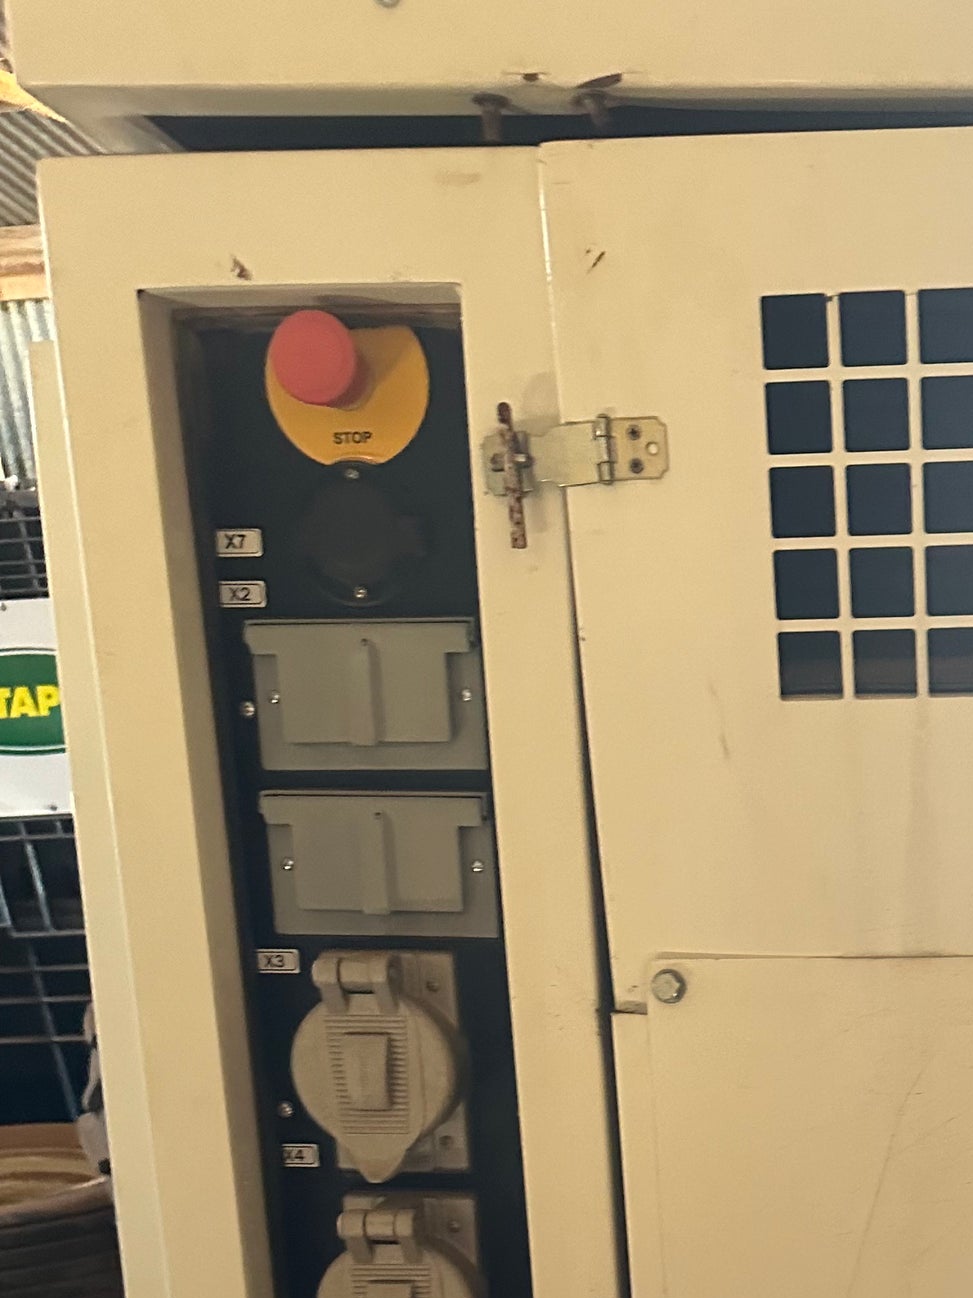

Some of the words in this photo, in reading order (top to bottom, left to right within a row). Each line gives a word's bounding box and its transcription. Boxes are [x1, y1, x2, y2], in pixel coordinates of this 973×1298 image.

[333, 431, 372, 445] STOP
[225, 534, 246, 549] X7
[230, 587, 251, 601] X2
[264, 955, 285, 968] X3
